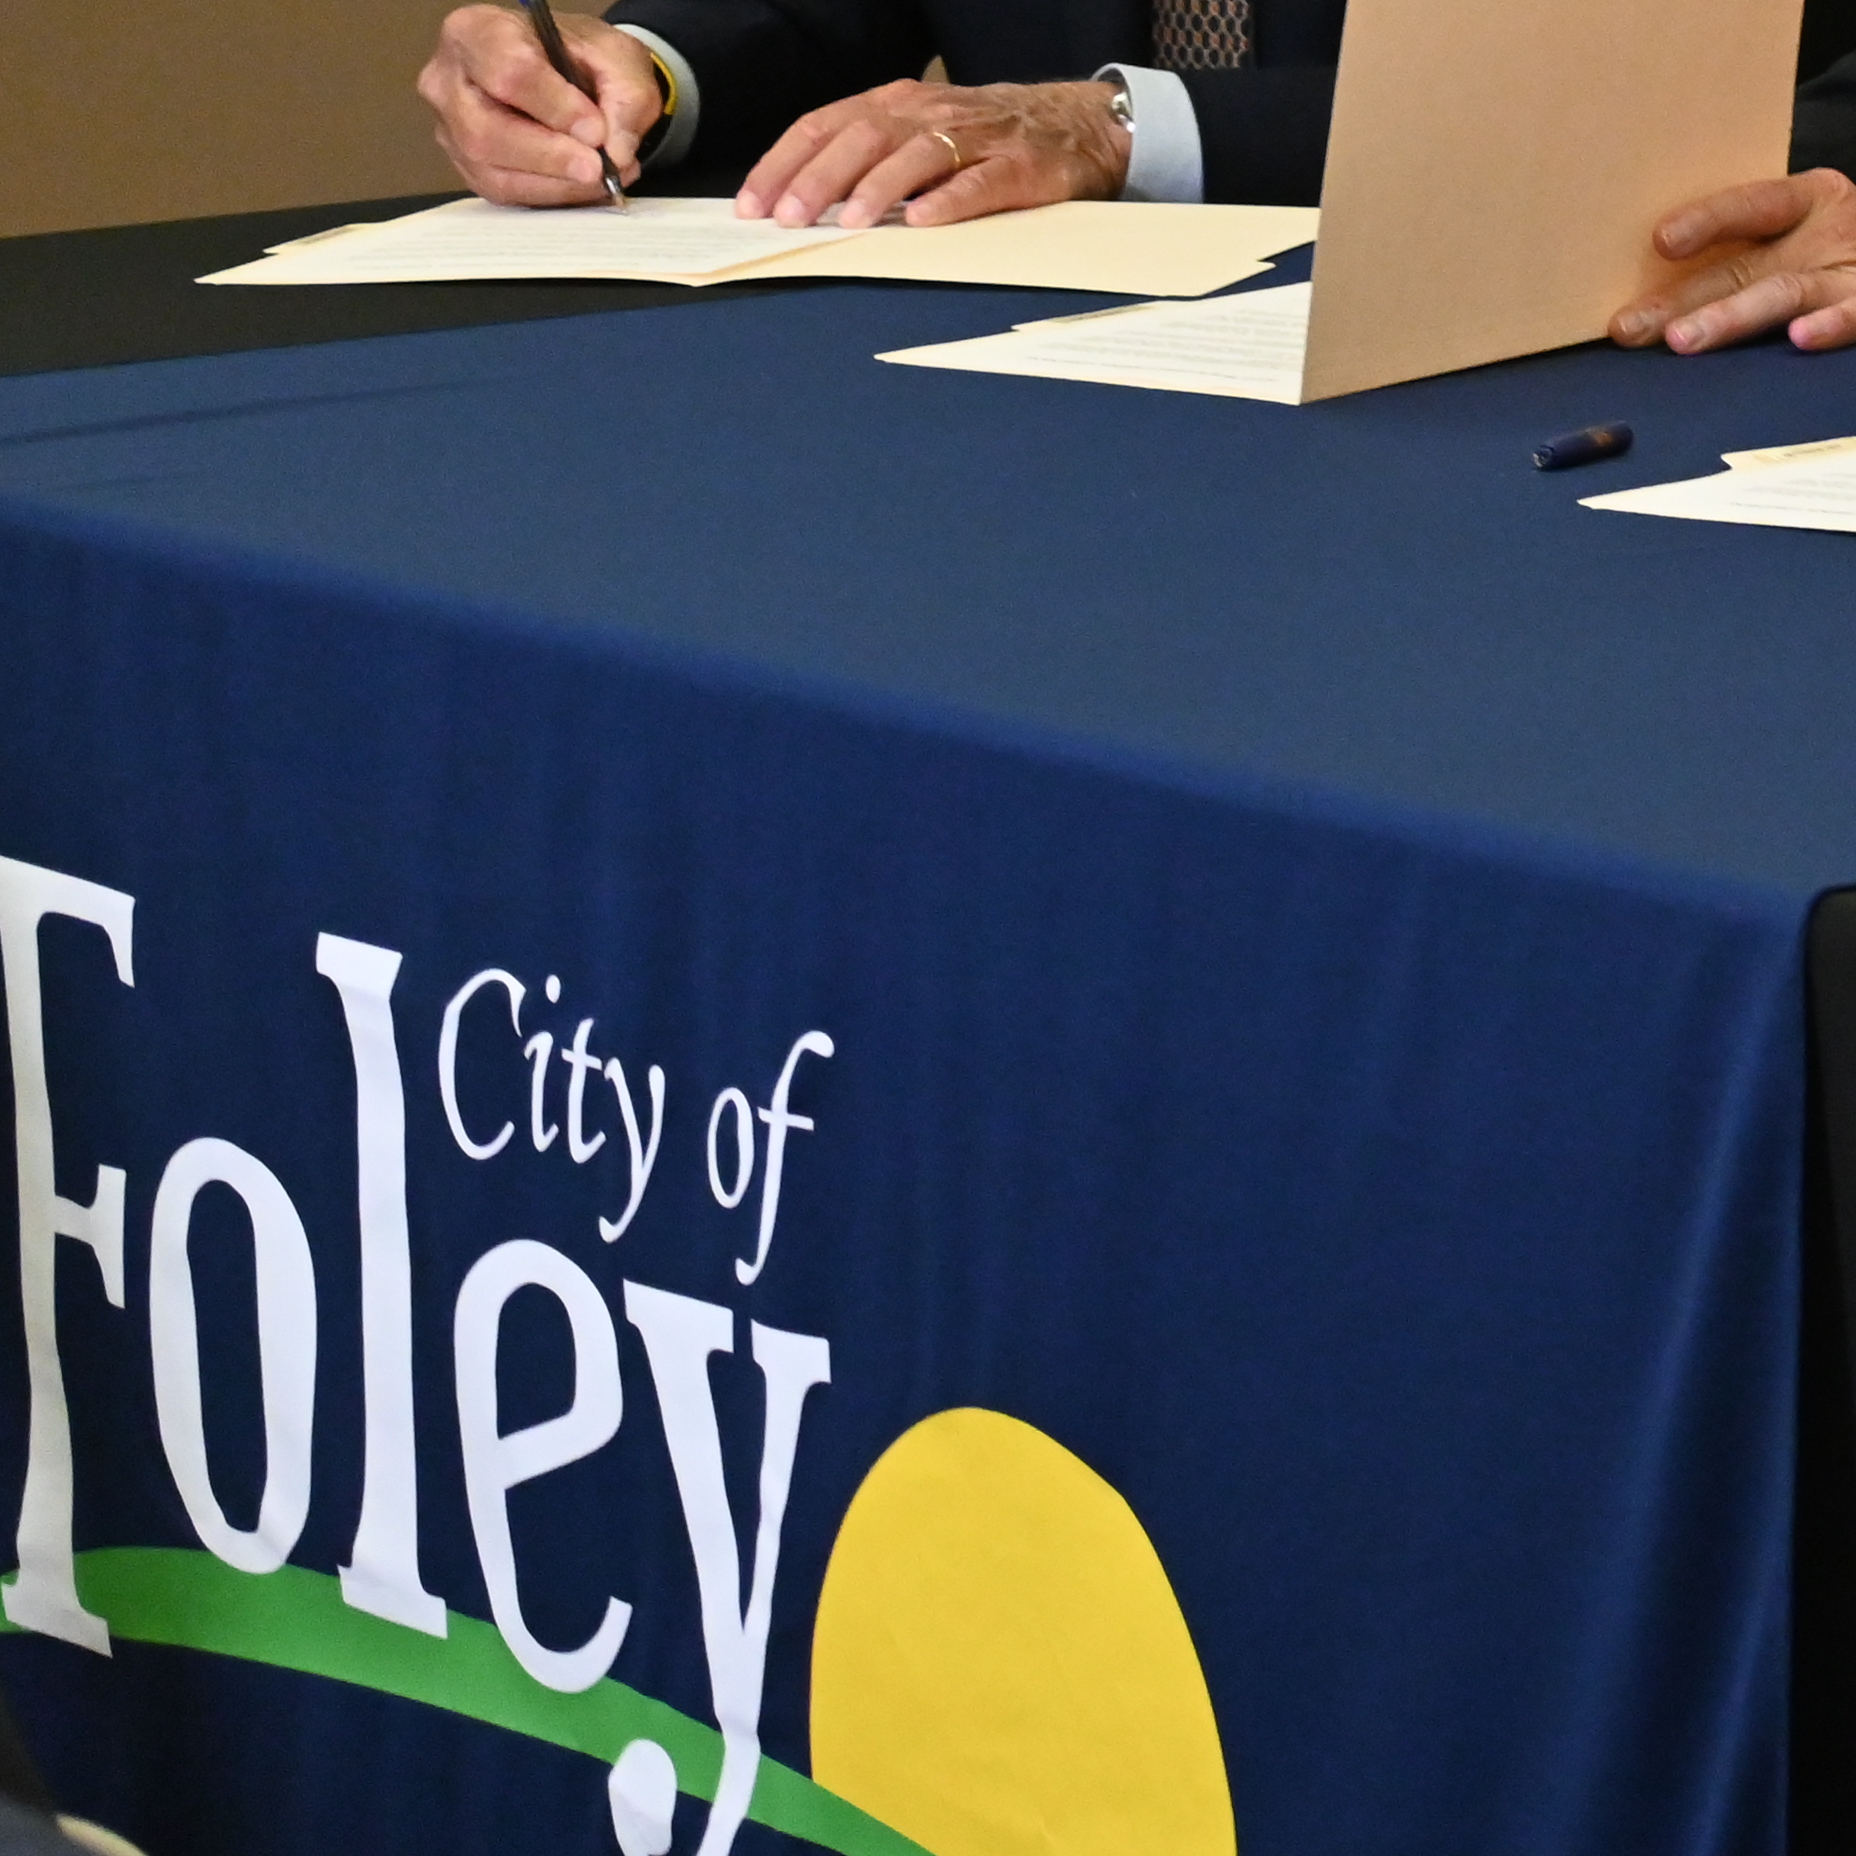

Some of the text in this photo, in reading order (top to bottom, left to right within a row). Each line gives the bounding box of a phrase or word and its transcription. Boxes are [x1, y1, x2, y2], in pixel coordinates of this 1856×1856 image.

[0, 855, 832, 1856] Foley
[438, 967, 836, 1285] City of
